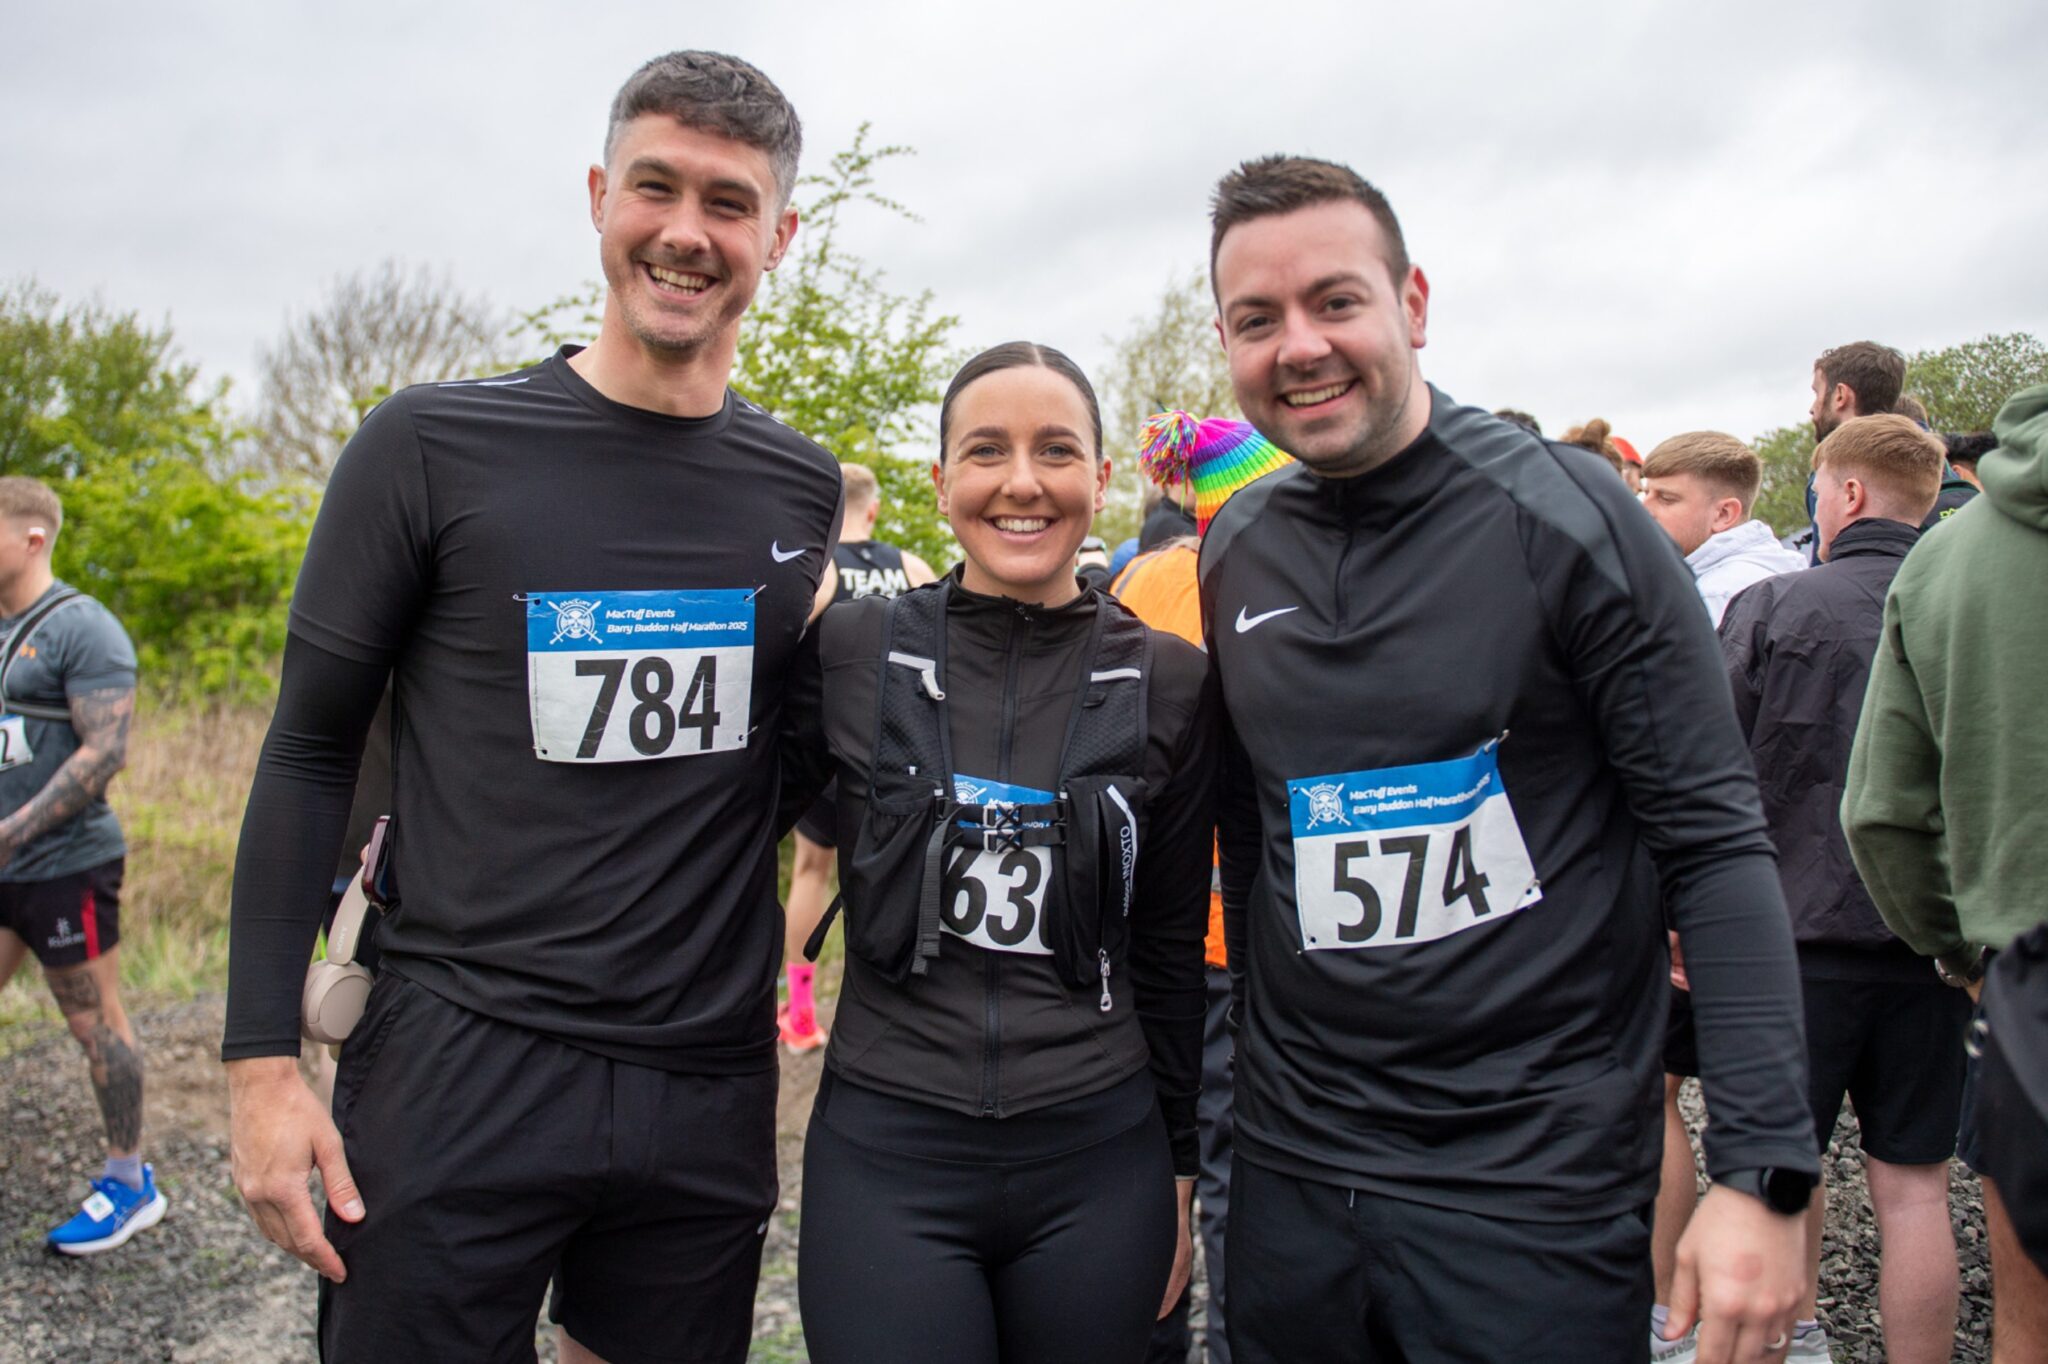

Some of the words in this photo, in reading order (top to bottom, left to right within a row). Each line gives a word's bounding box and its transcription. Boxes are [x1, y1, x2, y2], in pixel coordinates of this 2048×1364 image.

[840, 568, 908, 590] TEAM
[605, 609, 645, 620] MacTuff
[645, 609, 676, 618] Events
[607, 624, 632, 634] Barry
[634, 623, 669, 632] Buddon
[670, 622, 689, 634] Half
[688, 621, 727, 631] Marathon
[727, 621, 748, 631] 2025
[575, 655, 720, 758] 784
[1349, 786, 1386, 800] MacTuff
[1386, 784, 1418, 796] Events
[1353, 804, 1378, 815] Barry
[1378, 799, 1414, 812] Buddon
[1415, 796, 1434, 809] Half
[1120, 825, 1132, 880] INOXTO
[1334, 823, 1492, 943] 574
